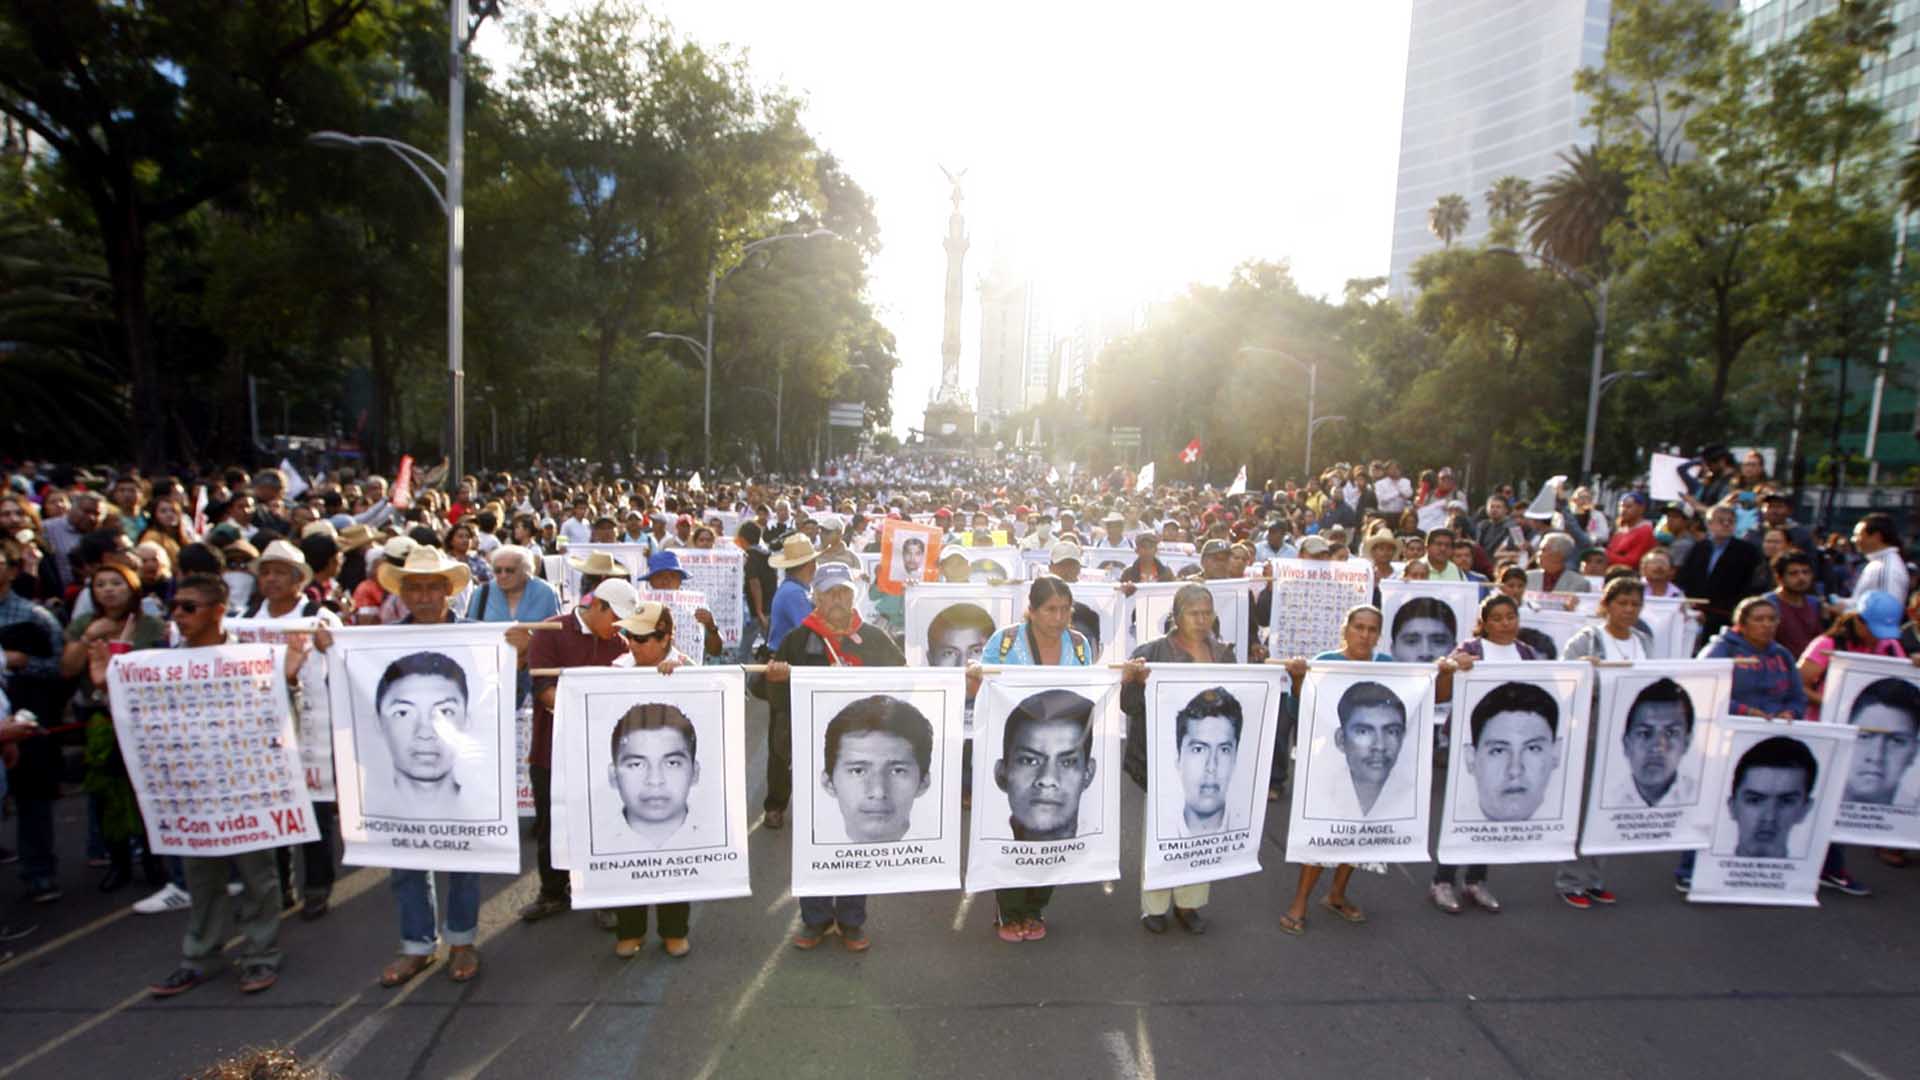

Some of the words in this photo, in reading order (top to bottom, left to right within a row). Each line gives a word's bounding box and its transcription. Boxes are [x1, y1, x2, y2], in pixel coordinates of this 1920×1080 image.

[166, 664, 183, 681] se
[188, 659, 209, 680] los
[304, 767, 322, 791] A!
[176, 816, 211, 833] Con
[216, 813, 259, 833] vida
[269, 807, 307, 836] YA!
[356, 820, 426, 835] JHOSIVANI
[428, 824, 509, 837] GUERRERO
[1330, 824, 1357, 834] LUIS
[160, 835, 183, 847] los
[187, 829, 277, 849] queremos,
[392, 837, 412, 848] DE
[414, 839, 431, 849] LA
[433, 840, 472, 851] CRUZ
[1158, 837, 1220, 851] EMILIANO
[1221, 831, 1250, 843] ALEN
[1308, 836, 1356, 848] ABARCA
[1358, 835, 1413, 847] CARRILLO
[834, 848, 890, 859] CARLOS
[892, 844, 924, 855] IVÁN
[1000, 843, 1038, 856] SAÚL
[1040, 842, 1086, 855] BRUNO
[1163, 847, 1213, 862] GASPAR
[1215, 844, 1230, 854] DE
[1232, 842, 1246, 851] LA
[589, 857, 663, 872] BENJAMÍN
[666, 851, 739, 866] ASCENCIO
[811, 858, 873, 871] RAMÍREZ
[875, 856, 946, 868] VILLAREAL
[1015, 855, 1067, 866] GARCÍA
[1189, 856, 1223, 868] CRUZ
[631, 867, 700, 881] BAUTISTA
